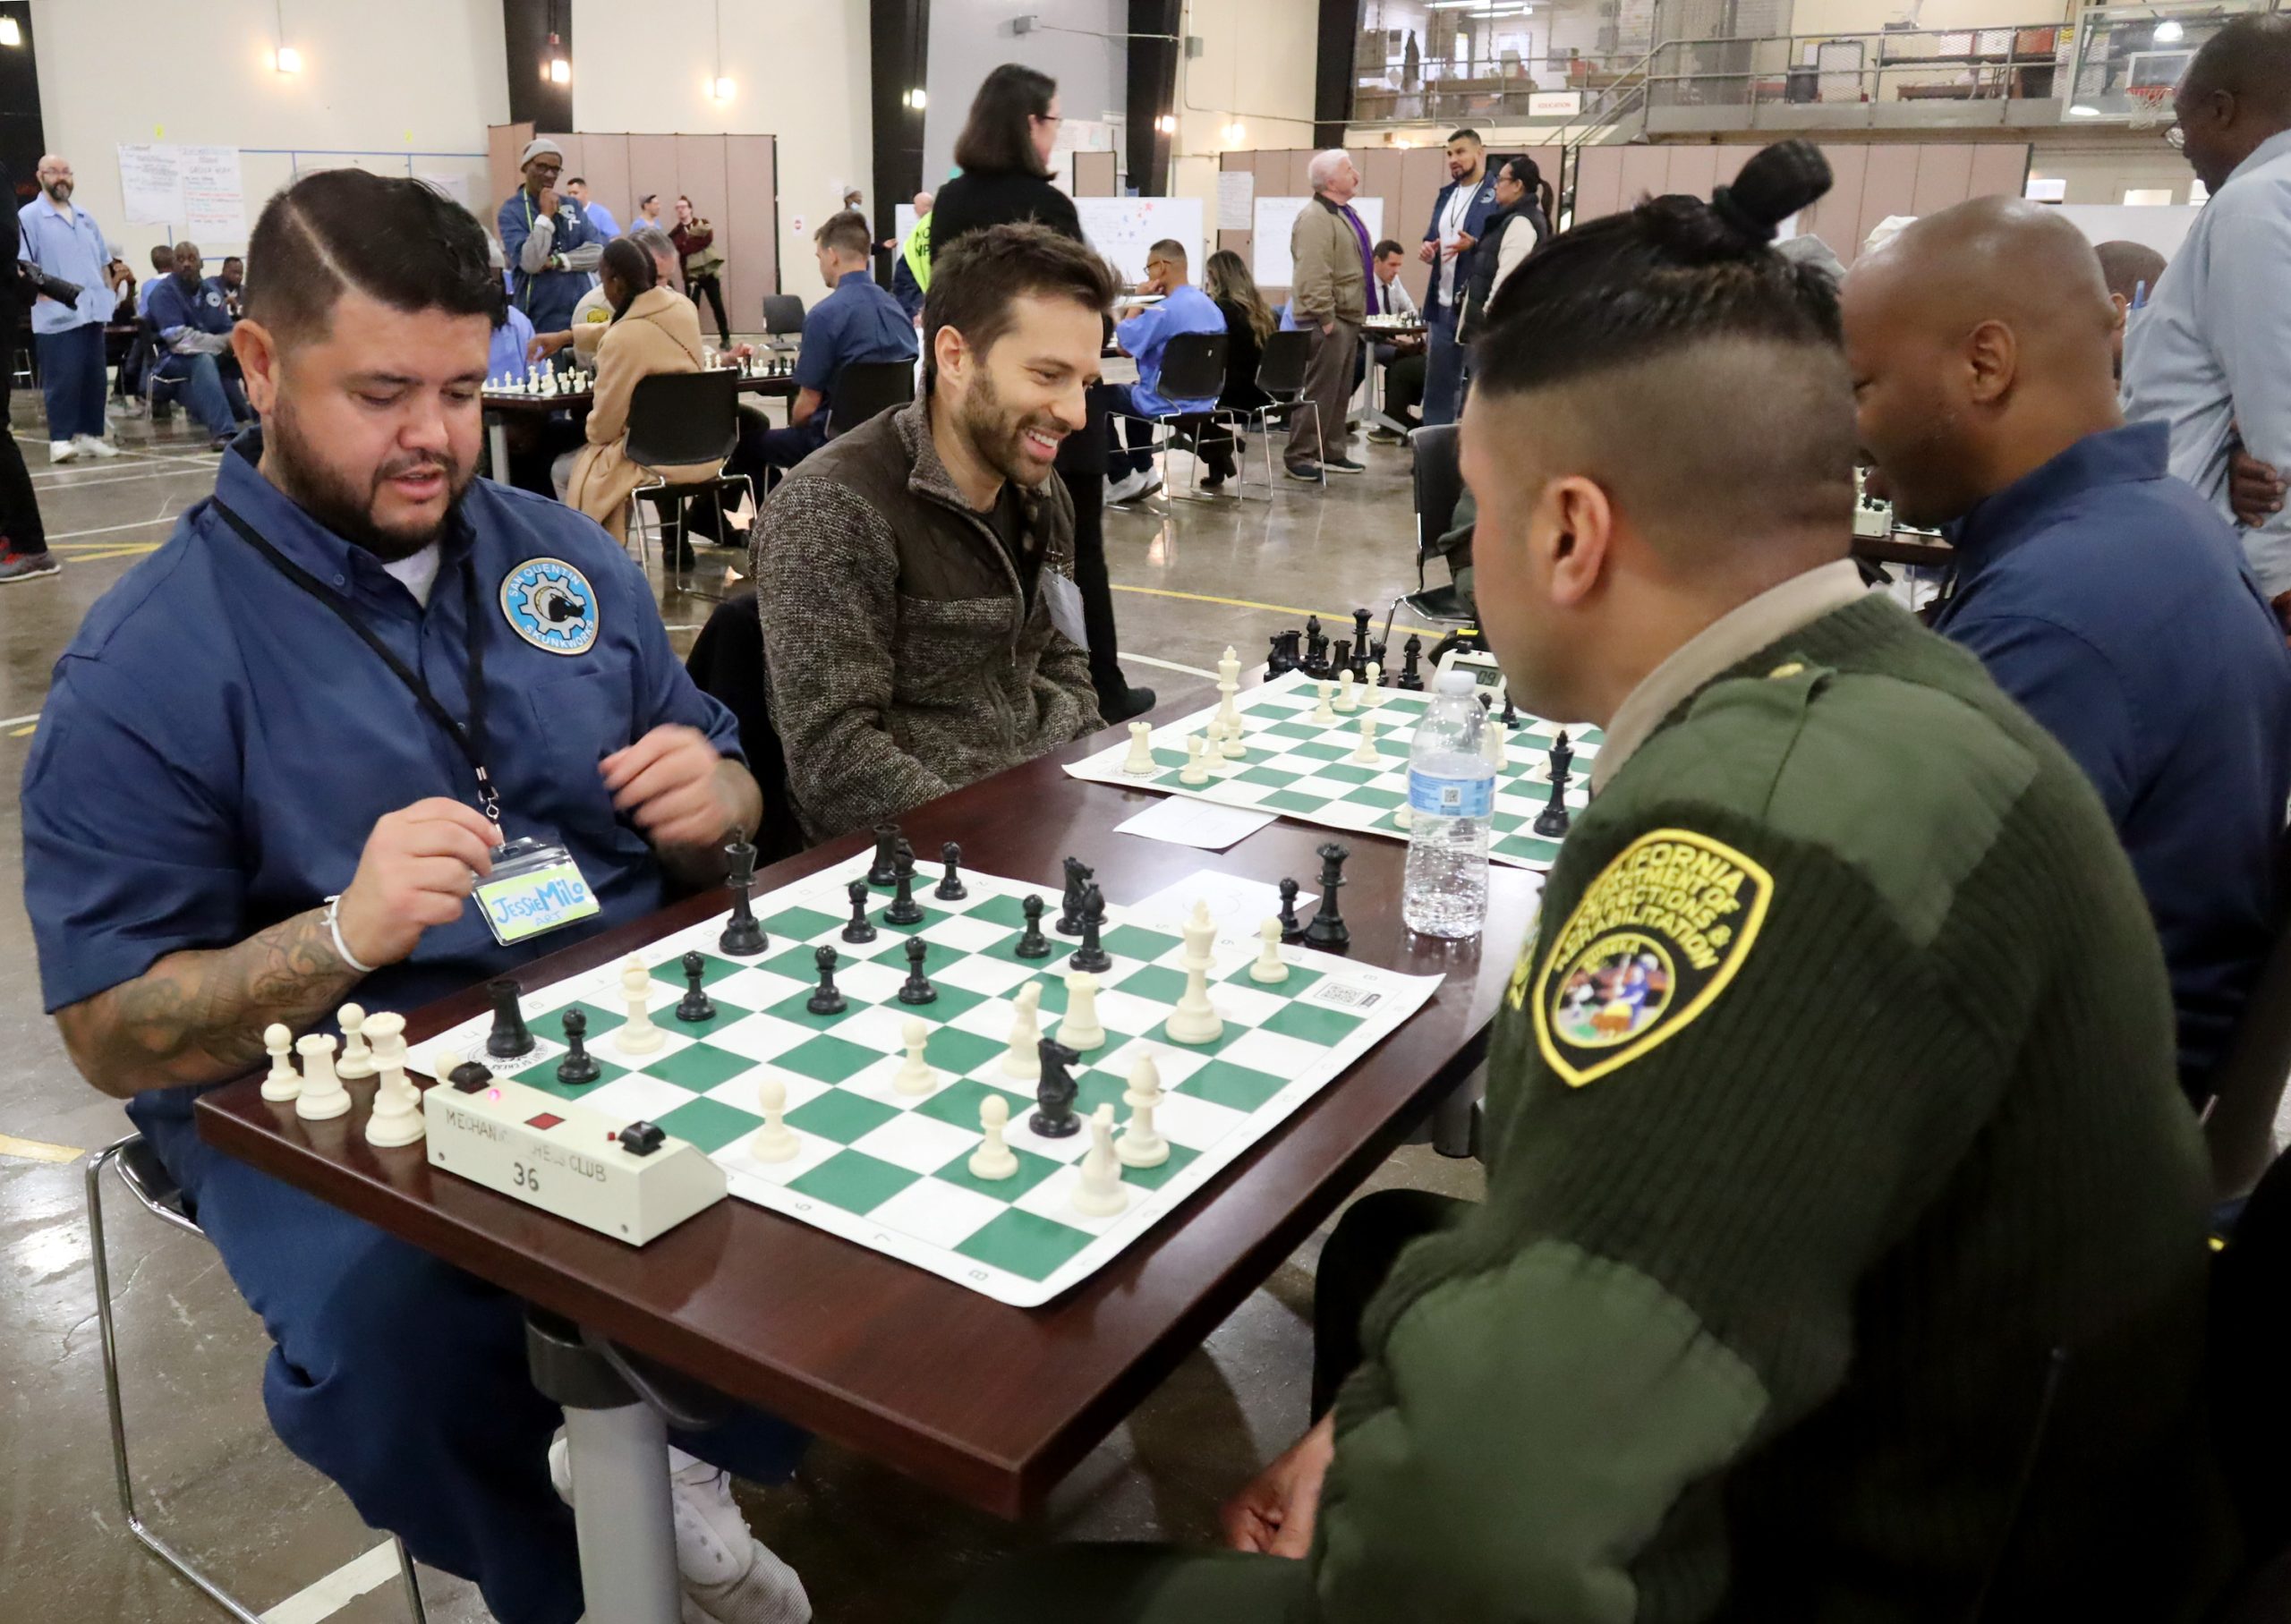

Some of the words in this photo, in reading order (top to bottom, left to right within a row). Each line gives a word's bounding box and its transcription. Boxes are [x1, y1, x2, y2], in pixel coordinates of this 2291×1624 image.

[508, 575, 525, 597] SAN
[523, 563, 581, 586] QUENTIN
[524, 618, 594, 649] SKUNKWORKS
[1701, 886, 1742, 915] OF
[1707, 923, 1732, 948] &
[513, 1161, 540, 1193] 36
[568, 1154, 608, 1183] CLUB
